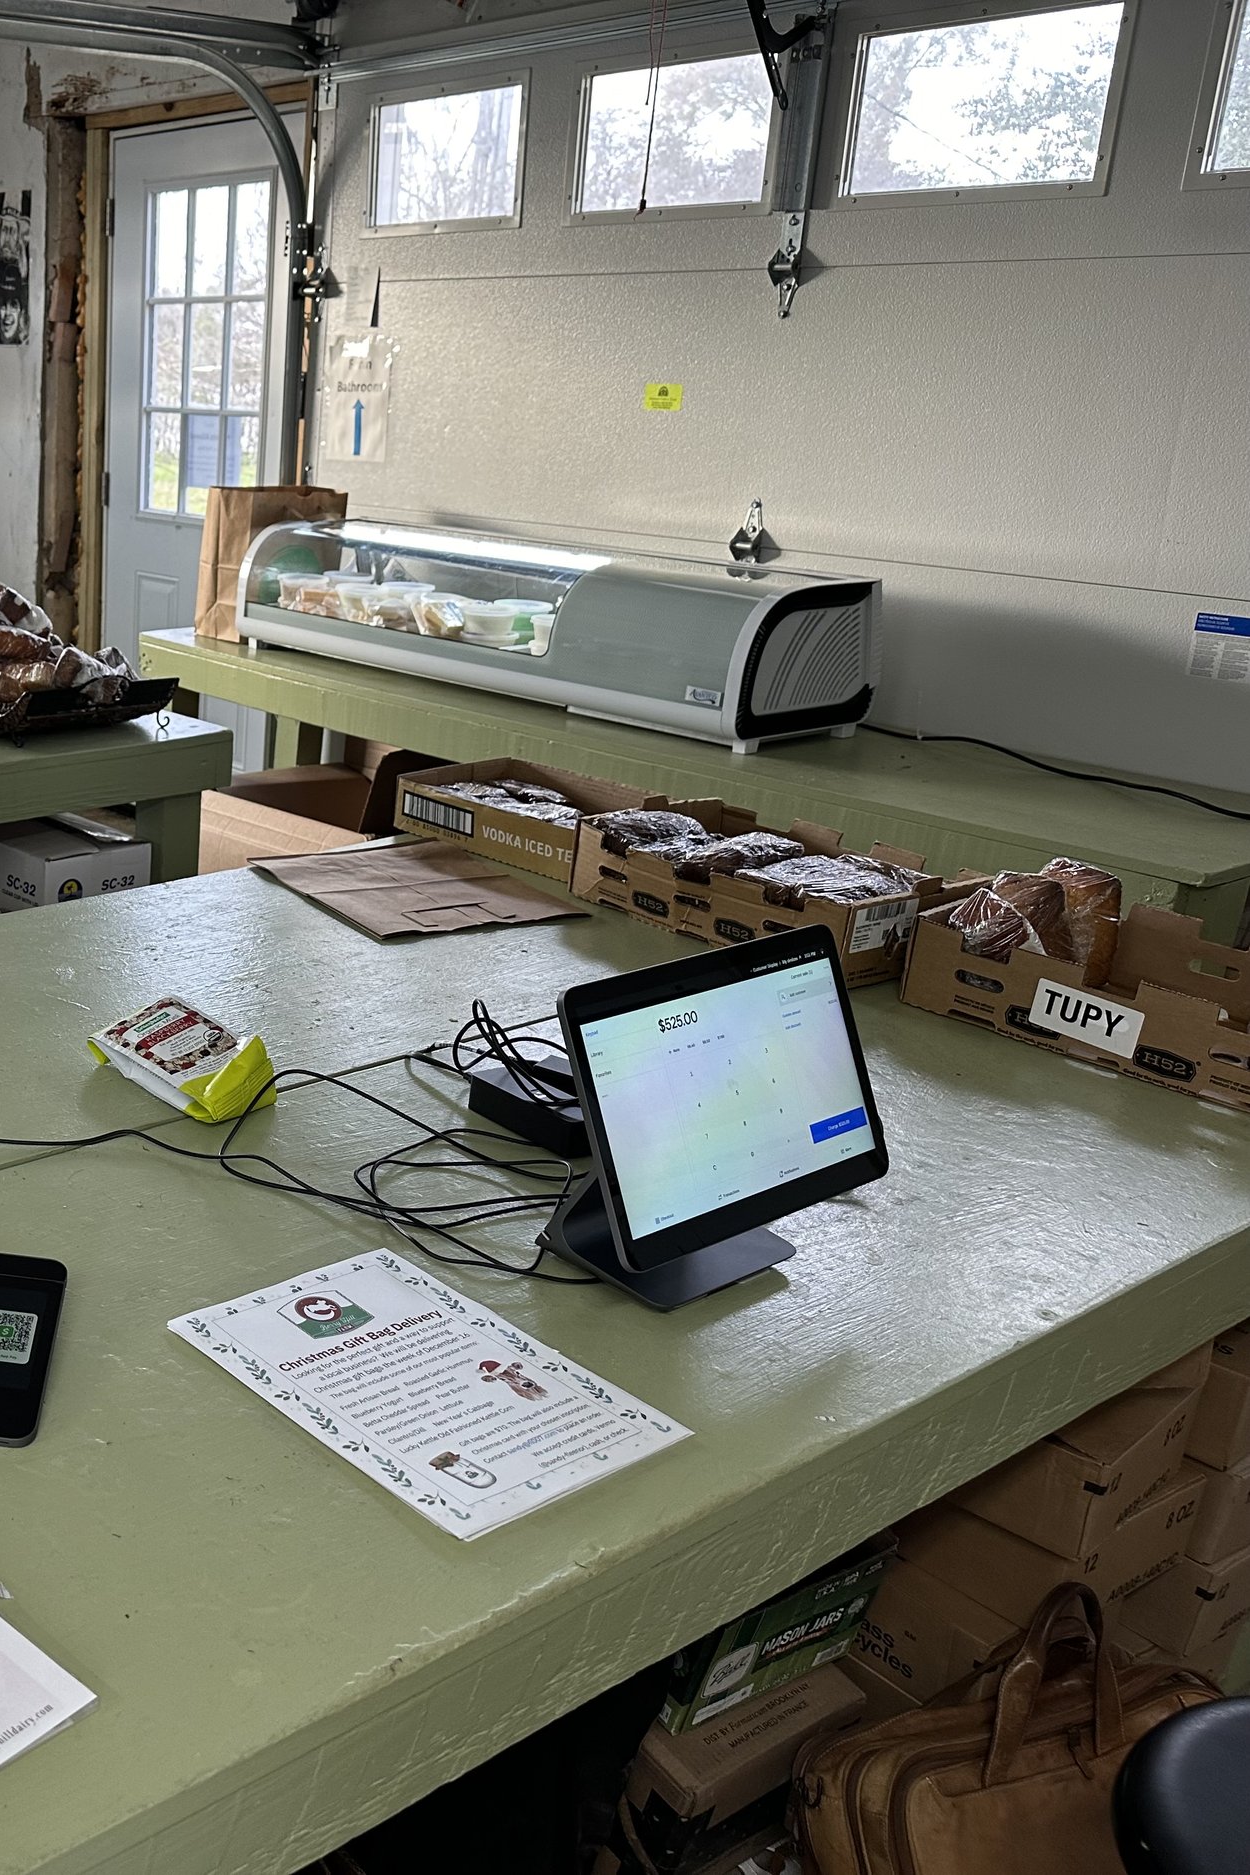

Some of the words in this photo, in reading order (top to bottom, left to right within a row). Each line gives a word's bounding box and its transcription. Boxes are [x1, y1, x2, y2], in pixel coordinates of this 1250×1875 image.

[482, 825, 521, 849] VODKA
[525, 838, 553, 858] ICED
[556, 848, 573, 863] TE
[6, 874, 36, 897] SC-32
[101, 875, 135, 891] SC-32
[636, 895, 664, 912] H52
[719, 923, 749, 941] H52
[657, 1010, 699, 1033] $525.00
[1044, 989, 1125, 1037] TUPY
[1142, 1051, 1188, 1075] H52
[278, 1345, 345, 1372] Christmas
[342, 1335, 370, 1349] Gift
[365, 1326, 395, 1341] Bag
[389, 1309, 441, 1332] Delivery
[290, 1365, 325, 1380] Looking
[319, 1360, 336, 1370] for
[331, 1356, 348, 1366] the
[345, 1347, 374, 1361] perfect
[371, 1342, 387, 1352] gift
[383, 1336, 400, 1347] and
[403, 1329, 421, 1339] way
[427, 1317, 456, 1331] support
[322, 1367, 345, 1379] local
[340, 1355, 380, 1373] business?
[392, 1344, 409, 1354] will
[415, 1328, 453, 1346] delivering
[1171, 1415, 1186, 1437] OZ
[1109, 1473, 1123, 1495] 12
[1165, 1514, 1174, 1530] 8
[1176, 1500, 1195, 1523] OZ
[1084, 1553, 1099, 1575] 12
[1217, 1582, 1230, 1602] 12
[761, 1624, 810, 1656] MASON
[809, 1607, 845, 1634] JARS
[859, 1619, 895, 1648] ass
[710, 1653, 752, 1687] Ball
[720, 1727, 730, 1737] BY
[765, 1688, 801, 1710] BROOKLYN
[799, 1682, 810, 1693] NY
[728, 1718, 779, 1748] MANUFACTURED
[778, 1712, 786, 1721] IN
[784, 1700, 809, 1719] FRANCE
